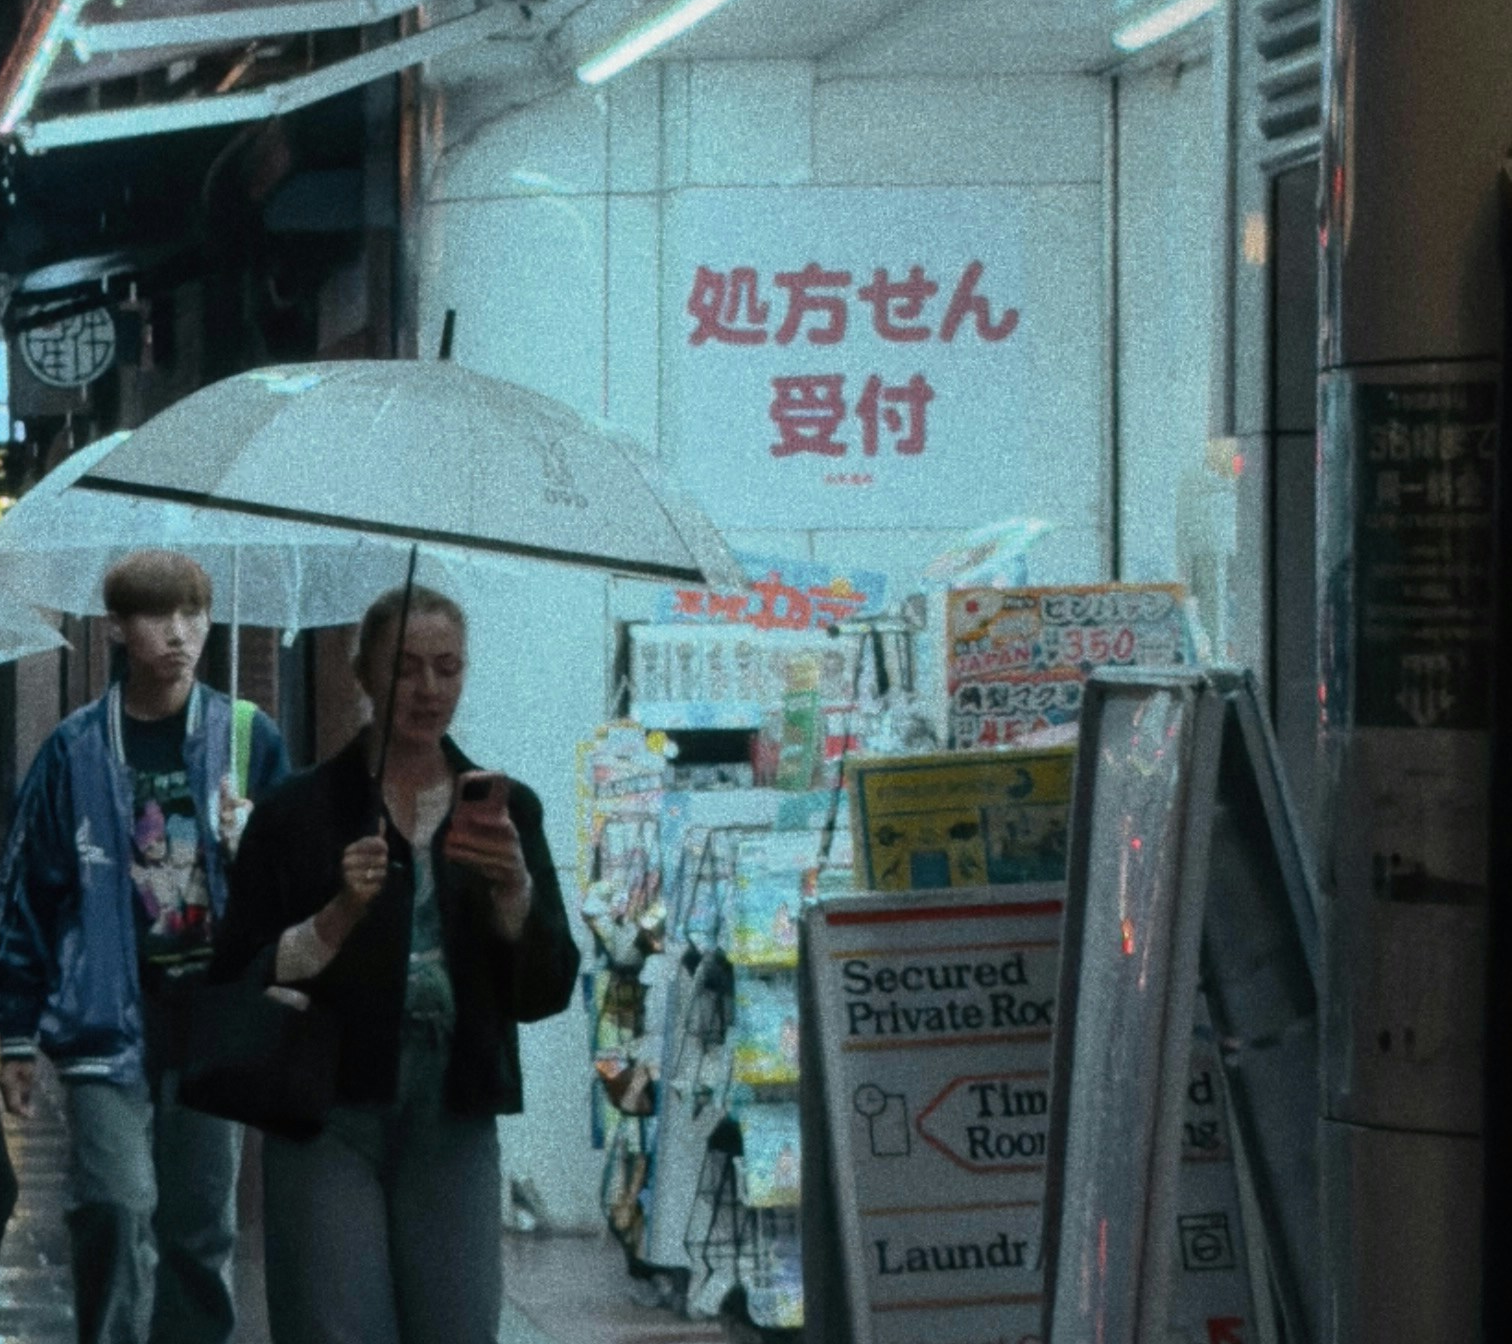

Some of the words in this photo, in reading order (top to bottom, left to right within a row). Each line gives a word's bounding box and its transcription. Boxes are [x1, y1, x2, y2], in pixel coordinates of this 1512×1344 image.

[686, 260, 1020, 347] 処方せん
[768, 371, 936, 459] 受付
[957, 645, 1031, 673] JAPAN
[842, 953, 1029, 996] Secured
[845, 999, 984, 1035] Private
